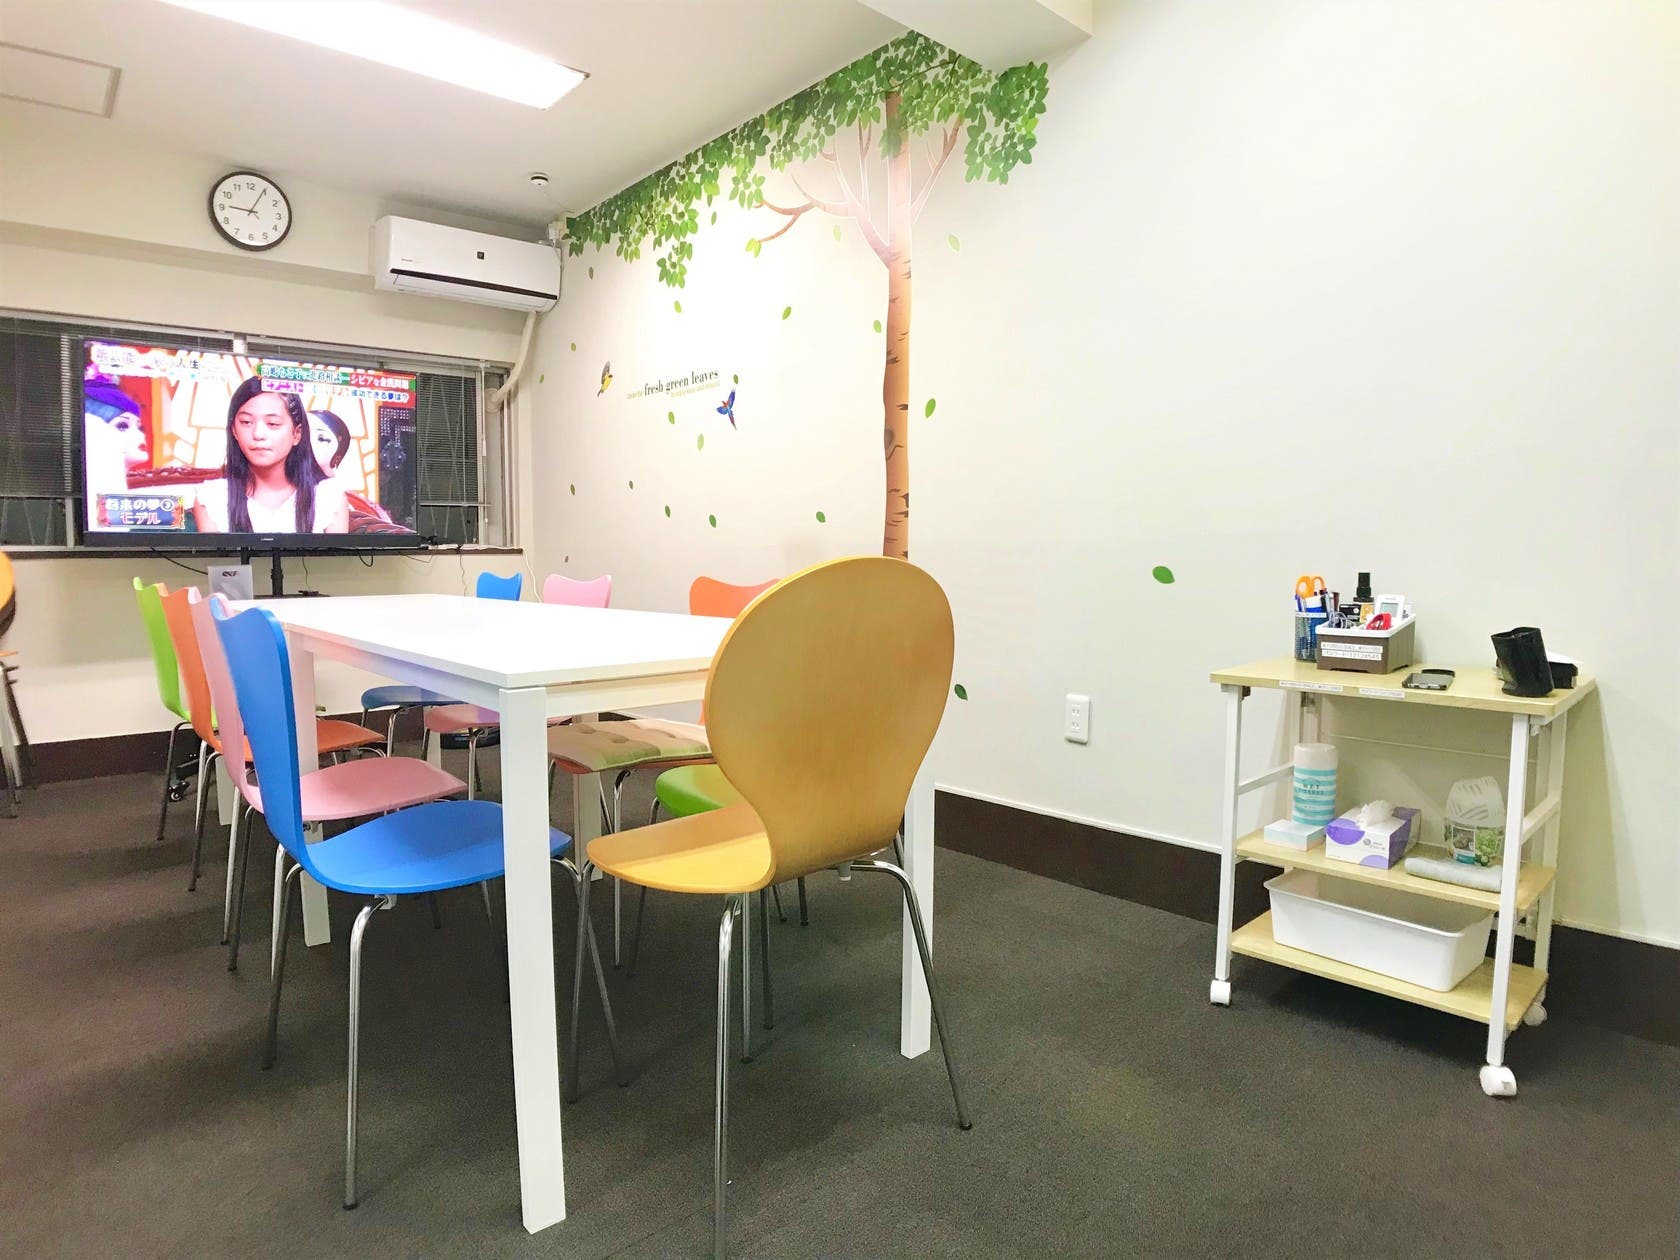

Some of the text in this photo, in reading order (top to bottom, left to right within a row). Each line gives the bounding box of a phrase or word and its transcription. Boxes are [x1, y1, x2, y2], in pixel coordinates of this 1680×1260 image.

[233, 183, 241, 191] 11
[246, 182, 256, 191] 12
[222, 191, 232, 199] 10
[218, 203, 225, 211] 9
[272, 199, 278, 207] 2
[223, 216, 229, 224] 8
[275, 212, 282, 220] 3
[272, 224, 278, 232] 4
[248, 233, 254, 241] 6
[262, 232, 268, 240] 5
[644, 380, 664, 396] fresh
[666, 377, 689, 395] green
[691, 370, 719, 385] leaves
[120, 511, 162, 525] モデル
